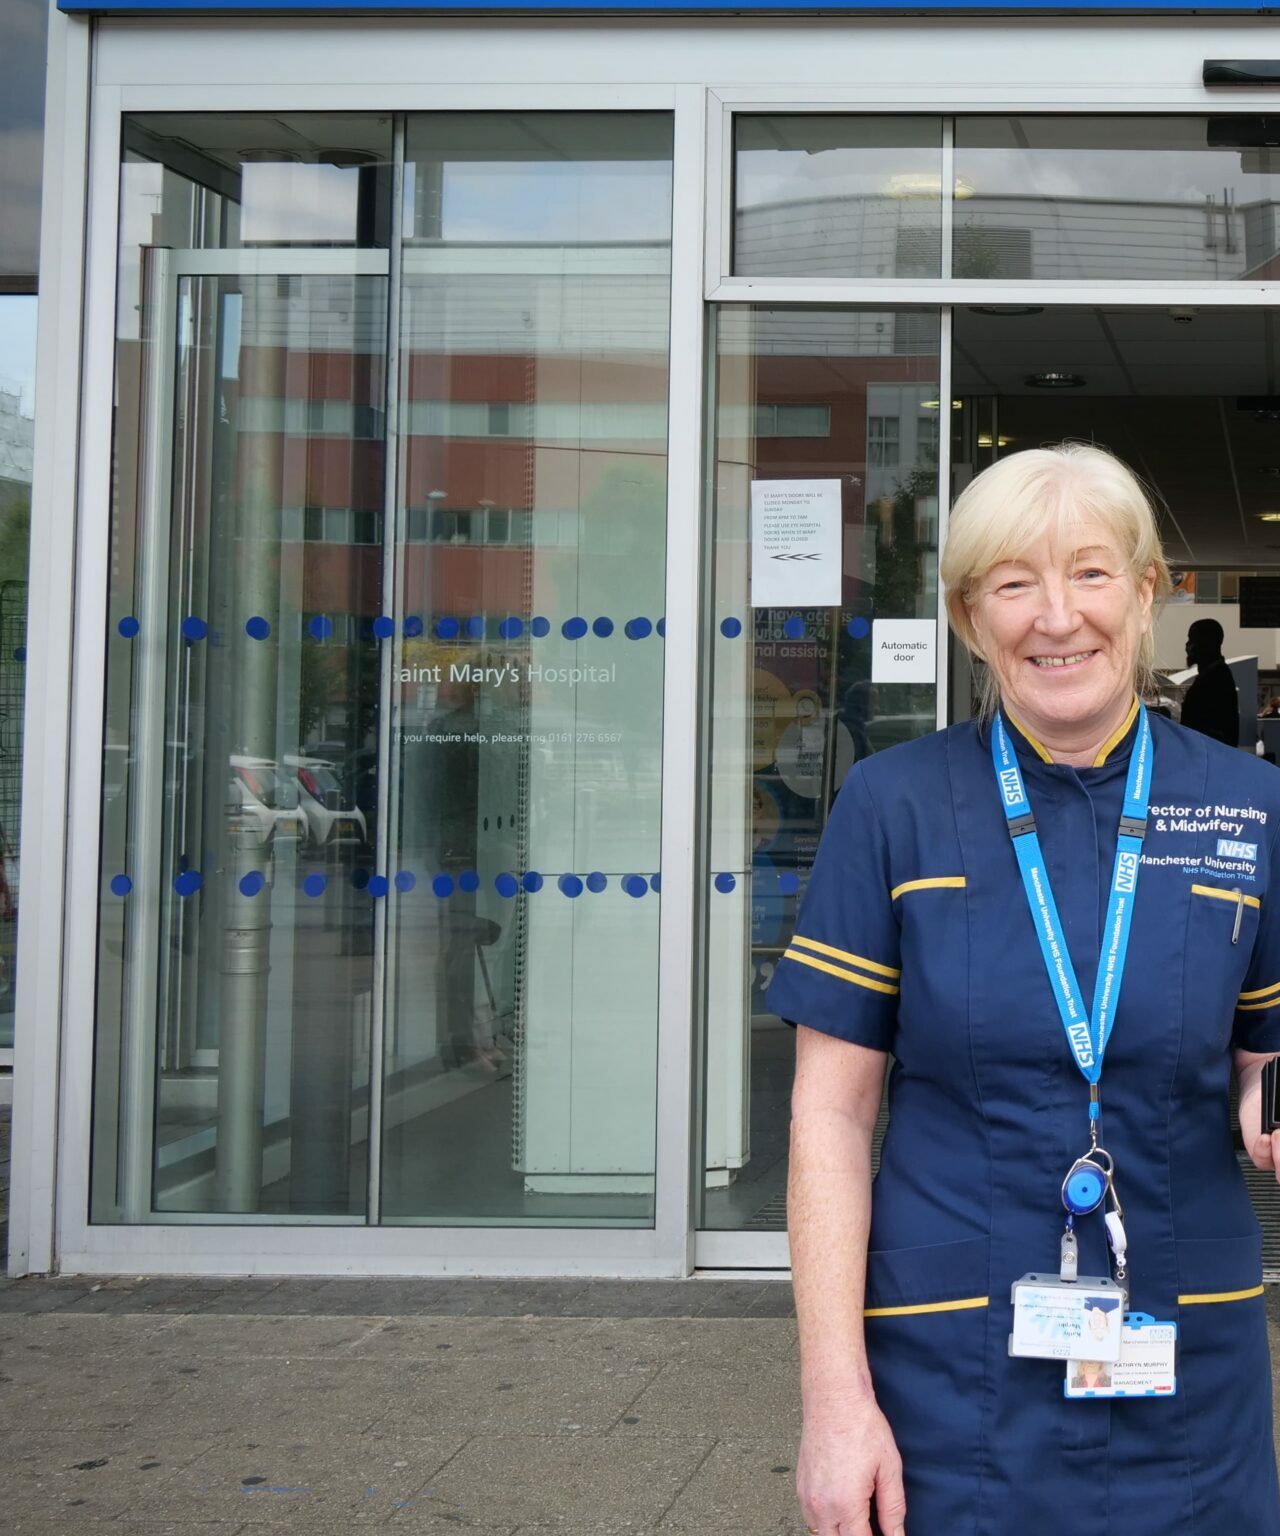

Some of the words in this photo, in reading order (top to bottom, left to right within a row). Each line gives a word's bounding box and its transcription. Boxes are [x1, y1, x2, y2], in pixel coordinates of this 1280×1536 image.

[881, 641, 928, 651] Automatic
[893, 653, 915, 662] door
[450, 663, 519, 687] Mary's
[528, 664, 616, 687] Hospital
[403, 734, 422, 744] you
[425, 733, 461, 744] require
[464, 732, 489, 744] help,
[491, 732, 523, 744] please
[526, 733, 546, 744] ring
[576, 733, 595, 743] 276
[1002, 770, 1022, 803] NHS
[1195, 805, 1212, 818] of
[1214, 805, 1267, 824] Nursing
[1155, 819, 1168, 832] &
[1170, 819, 1244, 836] Midwifery
[1219, 840, 1256, 859] NHS
[1117, 854, 1135, 891] NHS
[1183, 866, 1199, 874] NHS
[1200, 866, 1236, 880] Foundation
[1237, 872, 1256, 882] Trust
[1204, 856, 1256, 875] University
[1030, 867, 1046, 906] Manchester
[1116, 897, 1125, 915] Trust
[1041, 906, 1055, 941] University
[1109, 915, 1122, 954] Foundation
[1050, 941, 1061, 958] NHS
[1106, 955, 1116, 972] NHS
[1055, 958, 1072, 999] Foundation
[1101, 971, 1115, 1010] University
[1067, 998, 1078, 1019] Trust
[1070, 1025, 1093, 1064] NHS
